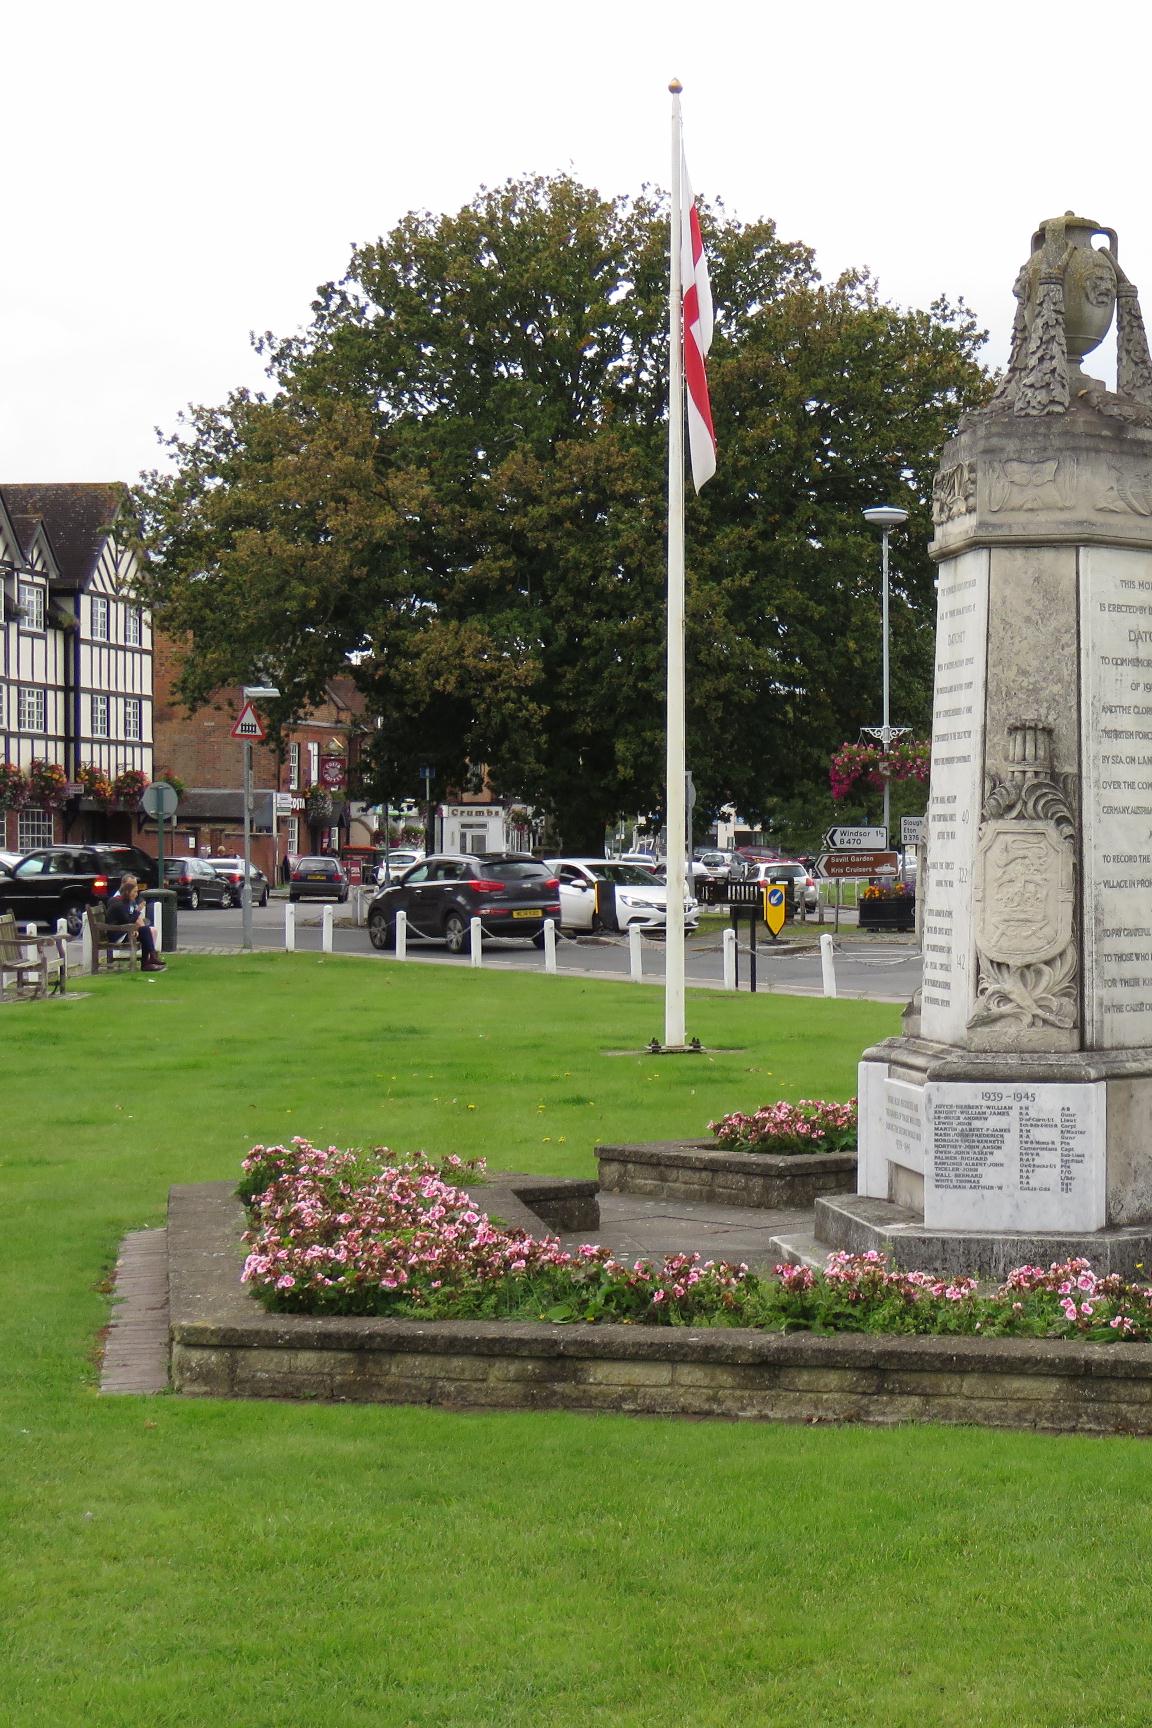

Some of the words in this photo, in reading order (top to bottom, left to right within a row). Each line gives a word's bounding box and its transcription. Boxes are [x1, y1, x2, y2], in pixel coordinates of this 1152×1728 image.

[1120, 580, 1135, 589] THIS
[1108, 604, 1136, 614] ERECTED
[1100, 656, 1110, 665] TO
[1130, 683, 1140, 691] OF
[1102, 755, 1110, 764] BY
[1126, 756, 1135, 765] ON
[1102, 781, 1121, 790] OVER
[1123, 781, 1135, 789] THE
[1103, 855, 1111, 863] TO
[1112, 855, 1137, 863] RECORD
[1140, 855, 1150, 863] THE
[1104, 954, 1112, 962] TO
[1114, 953, 1134, 962] THOSE
[1135, 952, 1149, 961] WHO
[1120, 978, 1140, 987] THEIR
